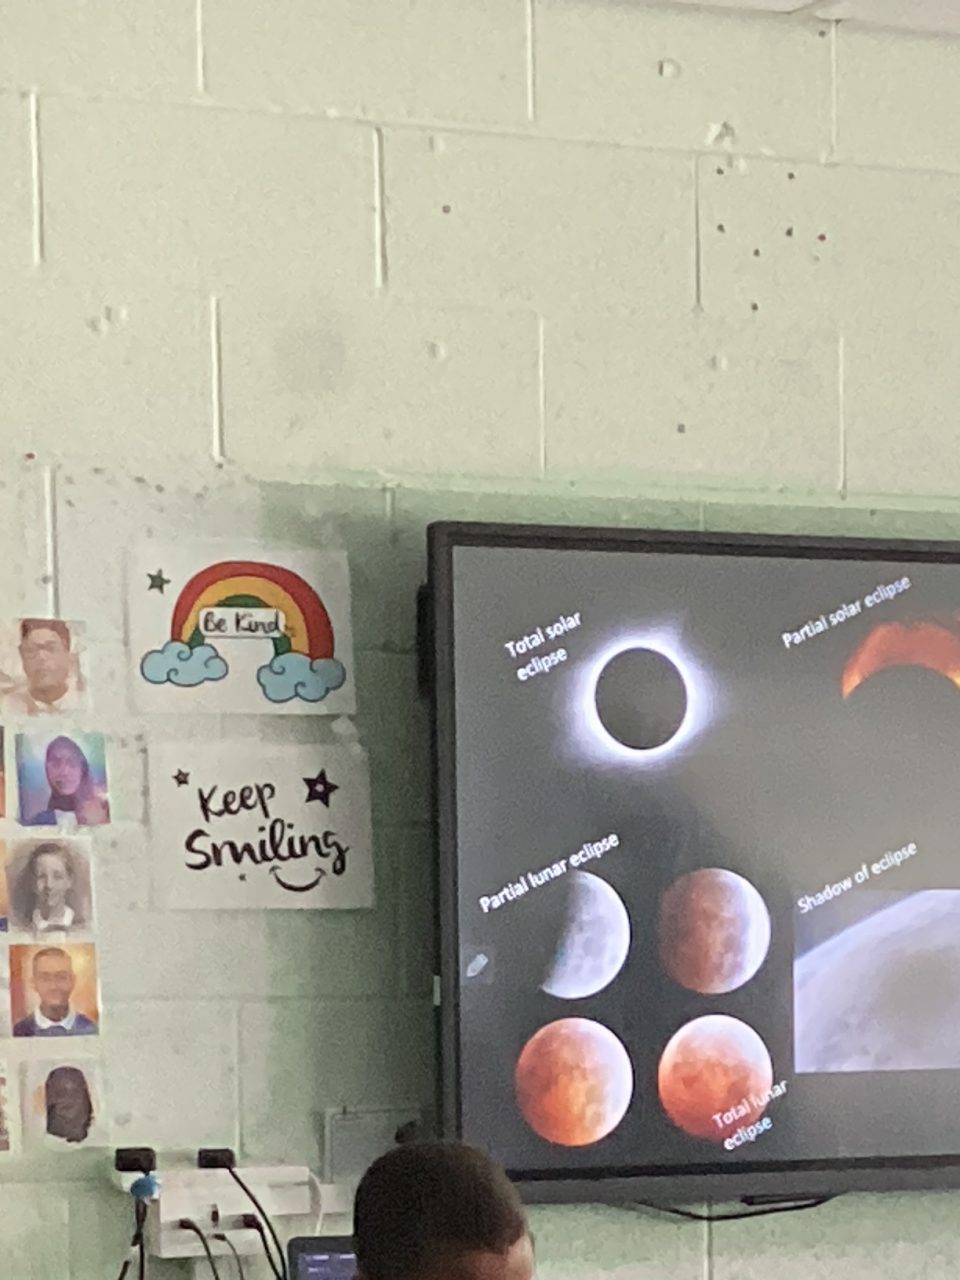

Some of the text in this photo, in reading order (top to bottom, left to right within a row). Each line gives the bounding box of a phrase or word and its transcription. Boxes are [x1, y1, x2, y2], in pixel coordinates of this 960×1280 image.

[203, 612, 281, 635] Be Kind
[505, 612, 583, 658] Total solar
[782, 576, 912, 649] Partial solar eclipse
[516, 647, 568, 682] eclipse
[198, 782, 276, 823] Keep
[184, 818, 350, 876] Smiling
[479, 833, 620, 914] Partial lunar eclipse
[797, 841, 919, 915] Shadow of eclipse
[711, 1079, 788, 1131] Total lunar
[723, 1115, 773, 1152] eclipse
